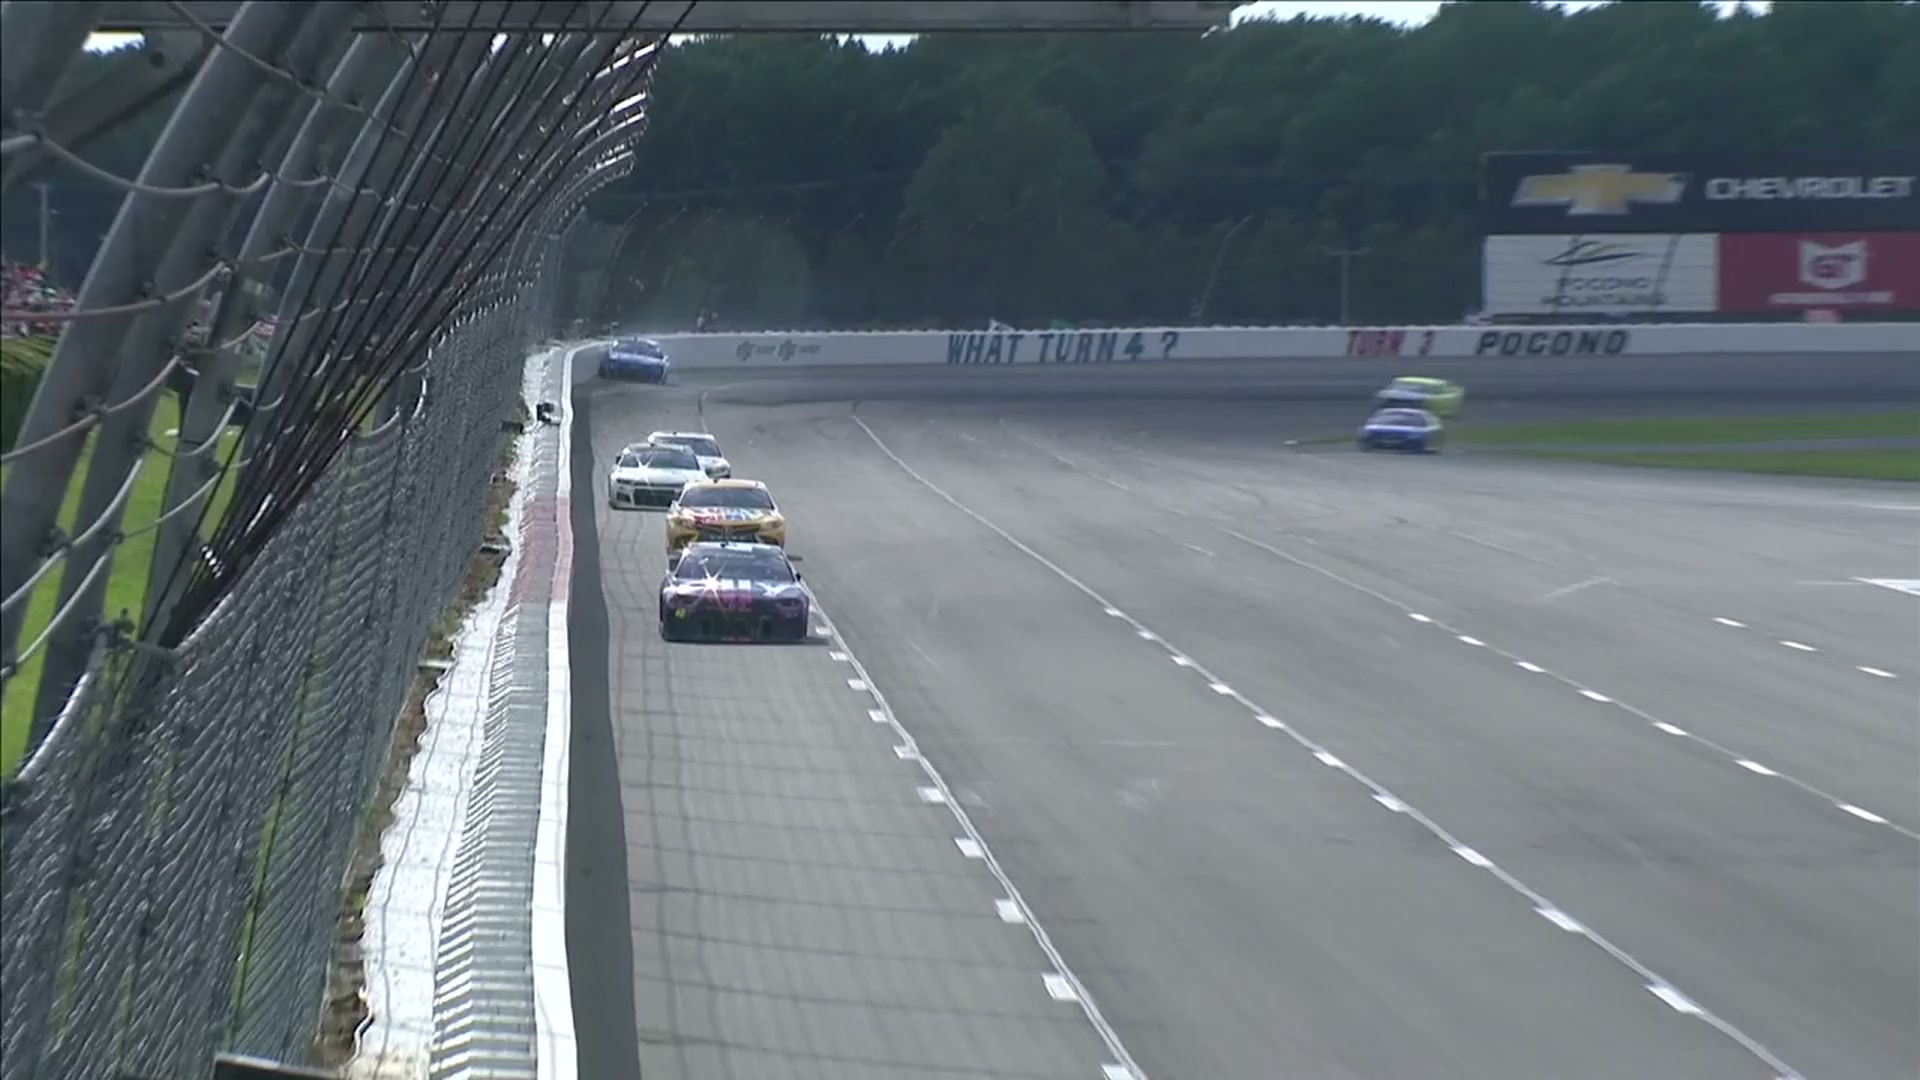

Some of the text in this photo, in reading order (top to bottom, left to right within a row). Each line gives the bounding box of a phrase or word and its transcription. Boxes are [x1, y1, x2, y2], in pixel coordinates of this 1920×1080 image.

[1705, 176, 1917, 200] CHEVROLET
[947, 331, 1180, 364] WHAT TURN 4 ?
[1346, 330, 1406, 356] TURN
[1475, 329, 1632, 356] POCONO
